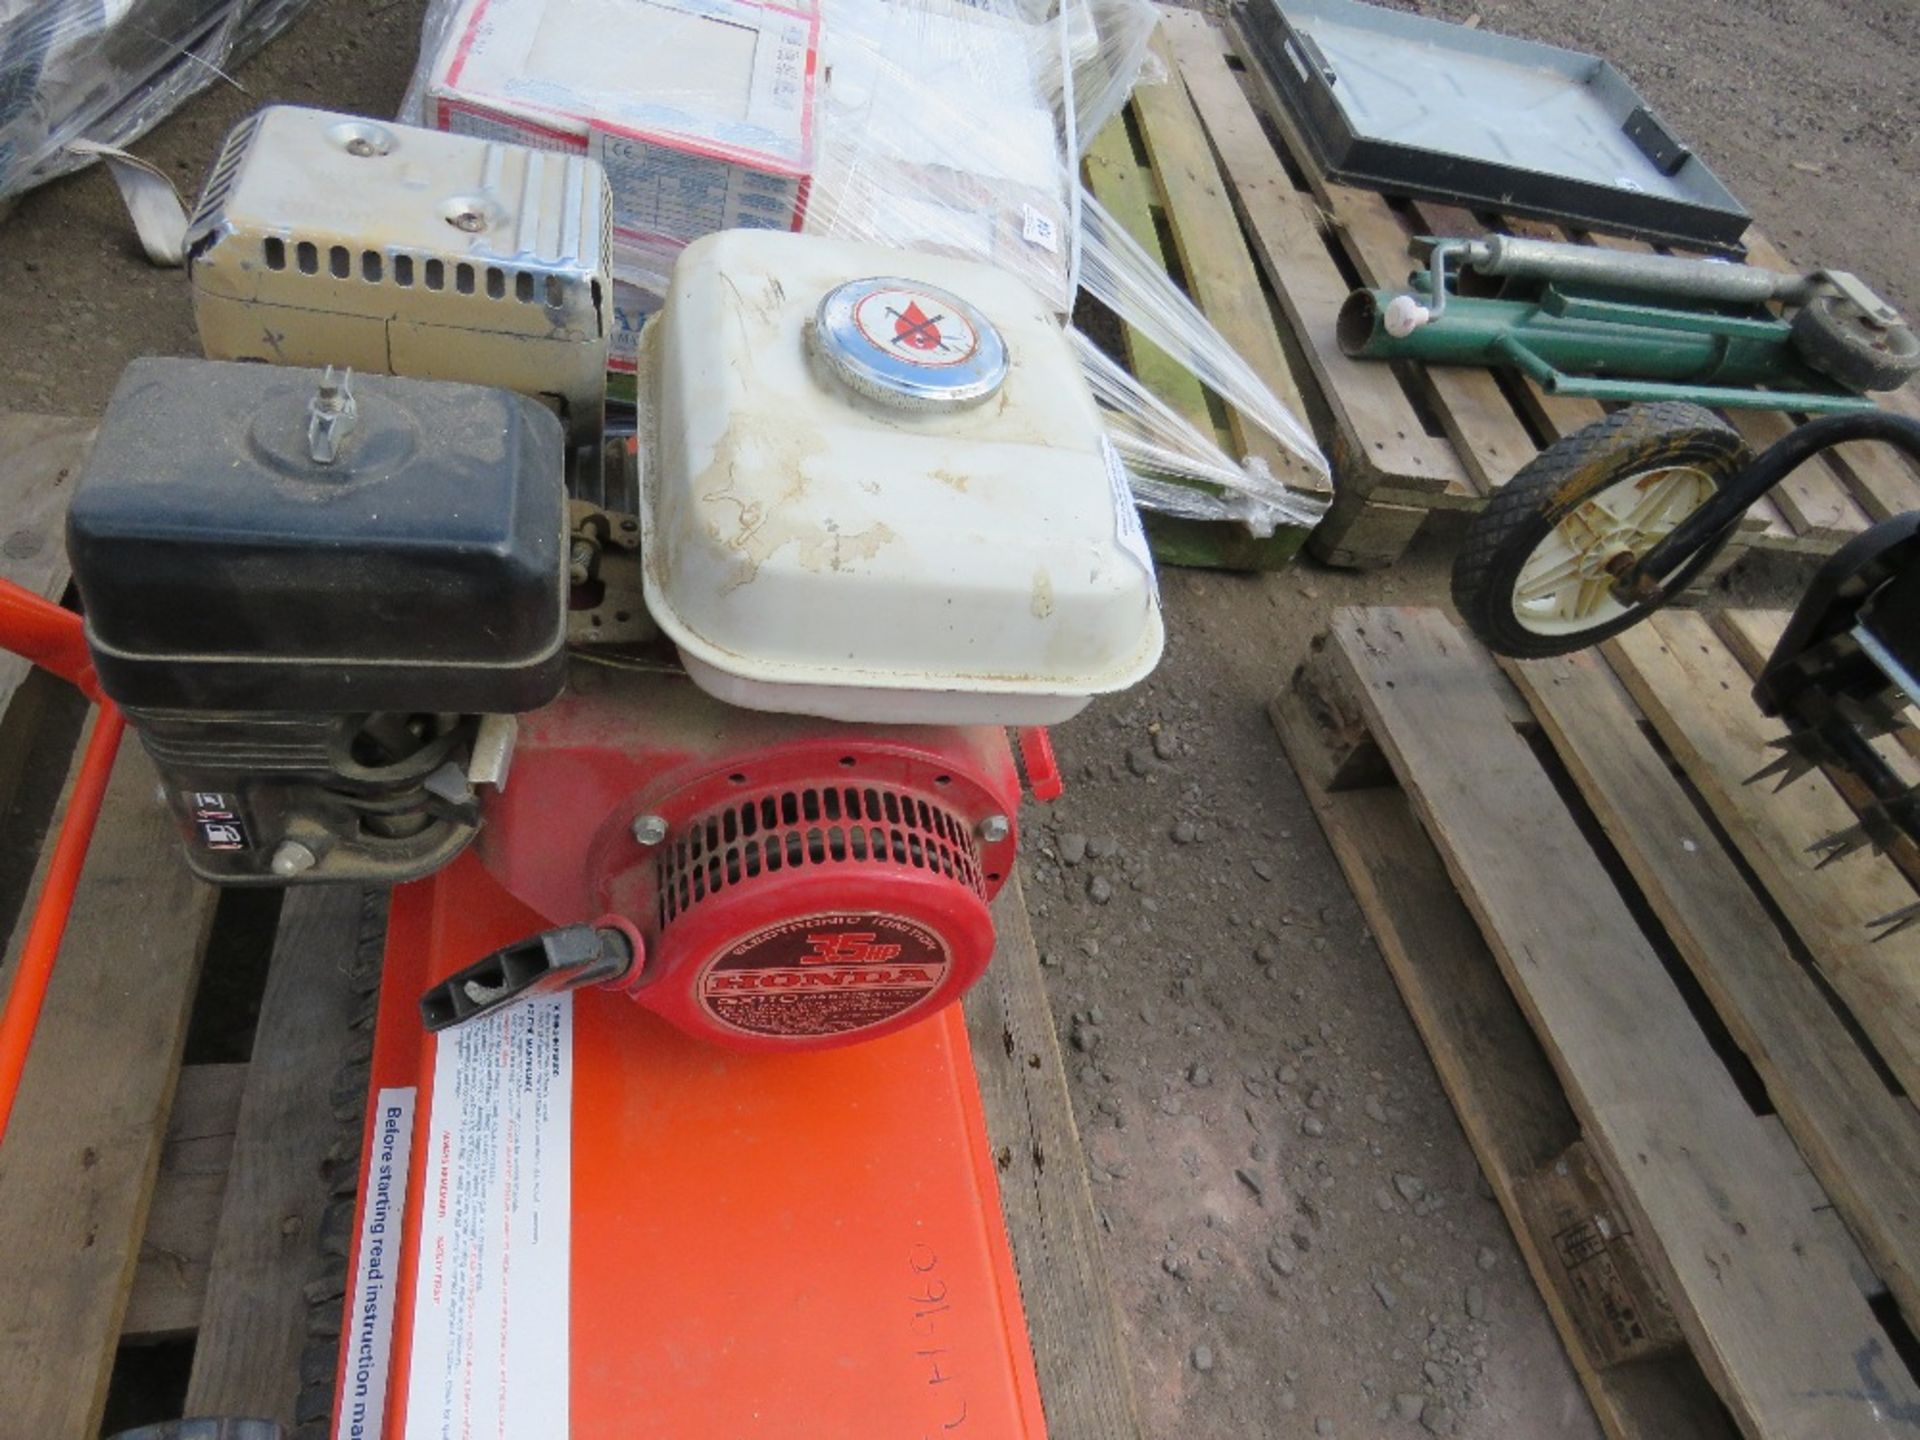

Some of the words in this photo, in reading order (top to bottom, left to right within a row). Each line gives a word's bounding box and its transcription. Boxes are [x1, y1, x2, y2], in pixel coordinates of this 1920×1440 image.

[711, 968, 934, 990] HONDA
[381, 1106, 402, 1162] Before
[370, 1164, 393, 1235] starting
[368, 1237, 384, 1281] read
[354, 1284, 383, 1397] instruction
[350, 1402, 368, 1440] ma
